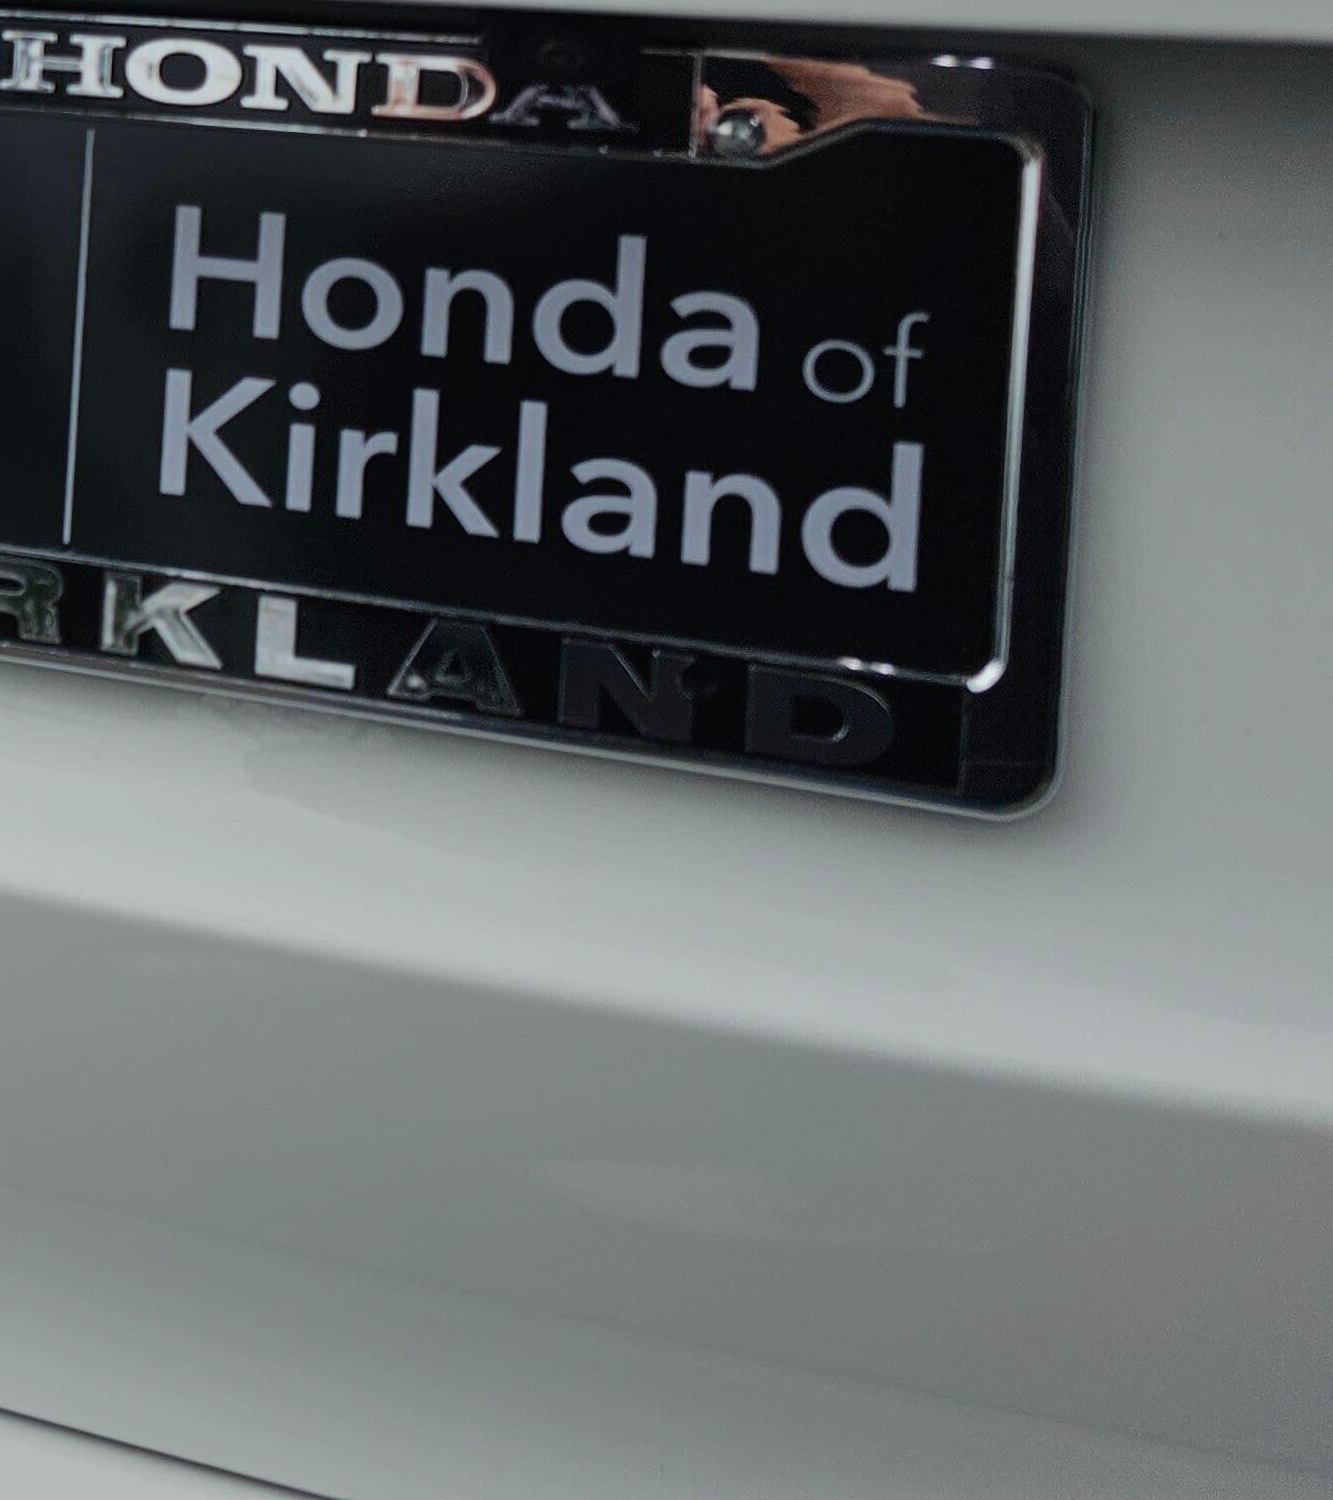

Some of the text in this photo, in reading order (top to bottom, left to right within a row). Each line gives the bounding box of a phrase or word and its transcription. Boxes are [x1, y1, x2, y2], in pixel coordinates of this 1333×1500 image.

[169, 202, 929, 407] Honda of
[158, 366, 925, 594] Kirkland
